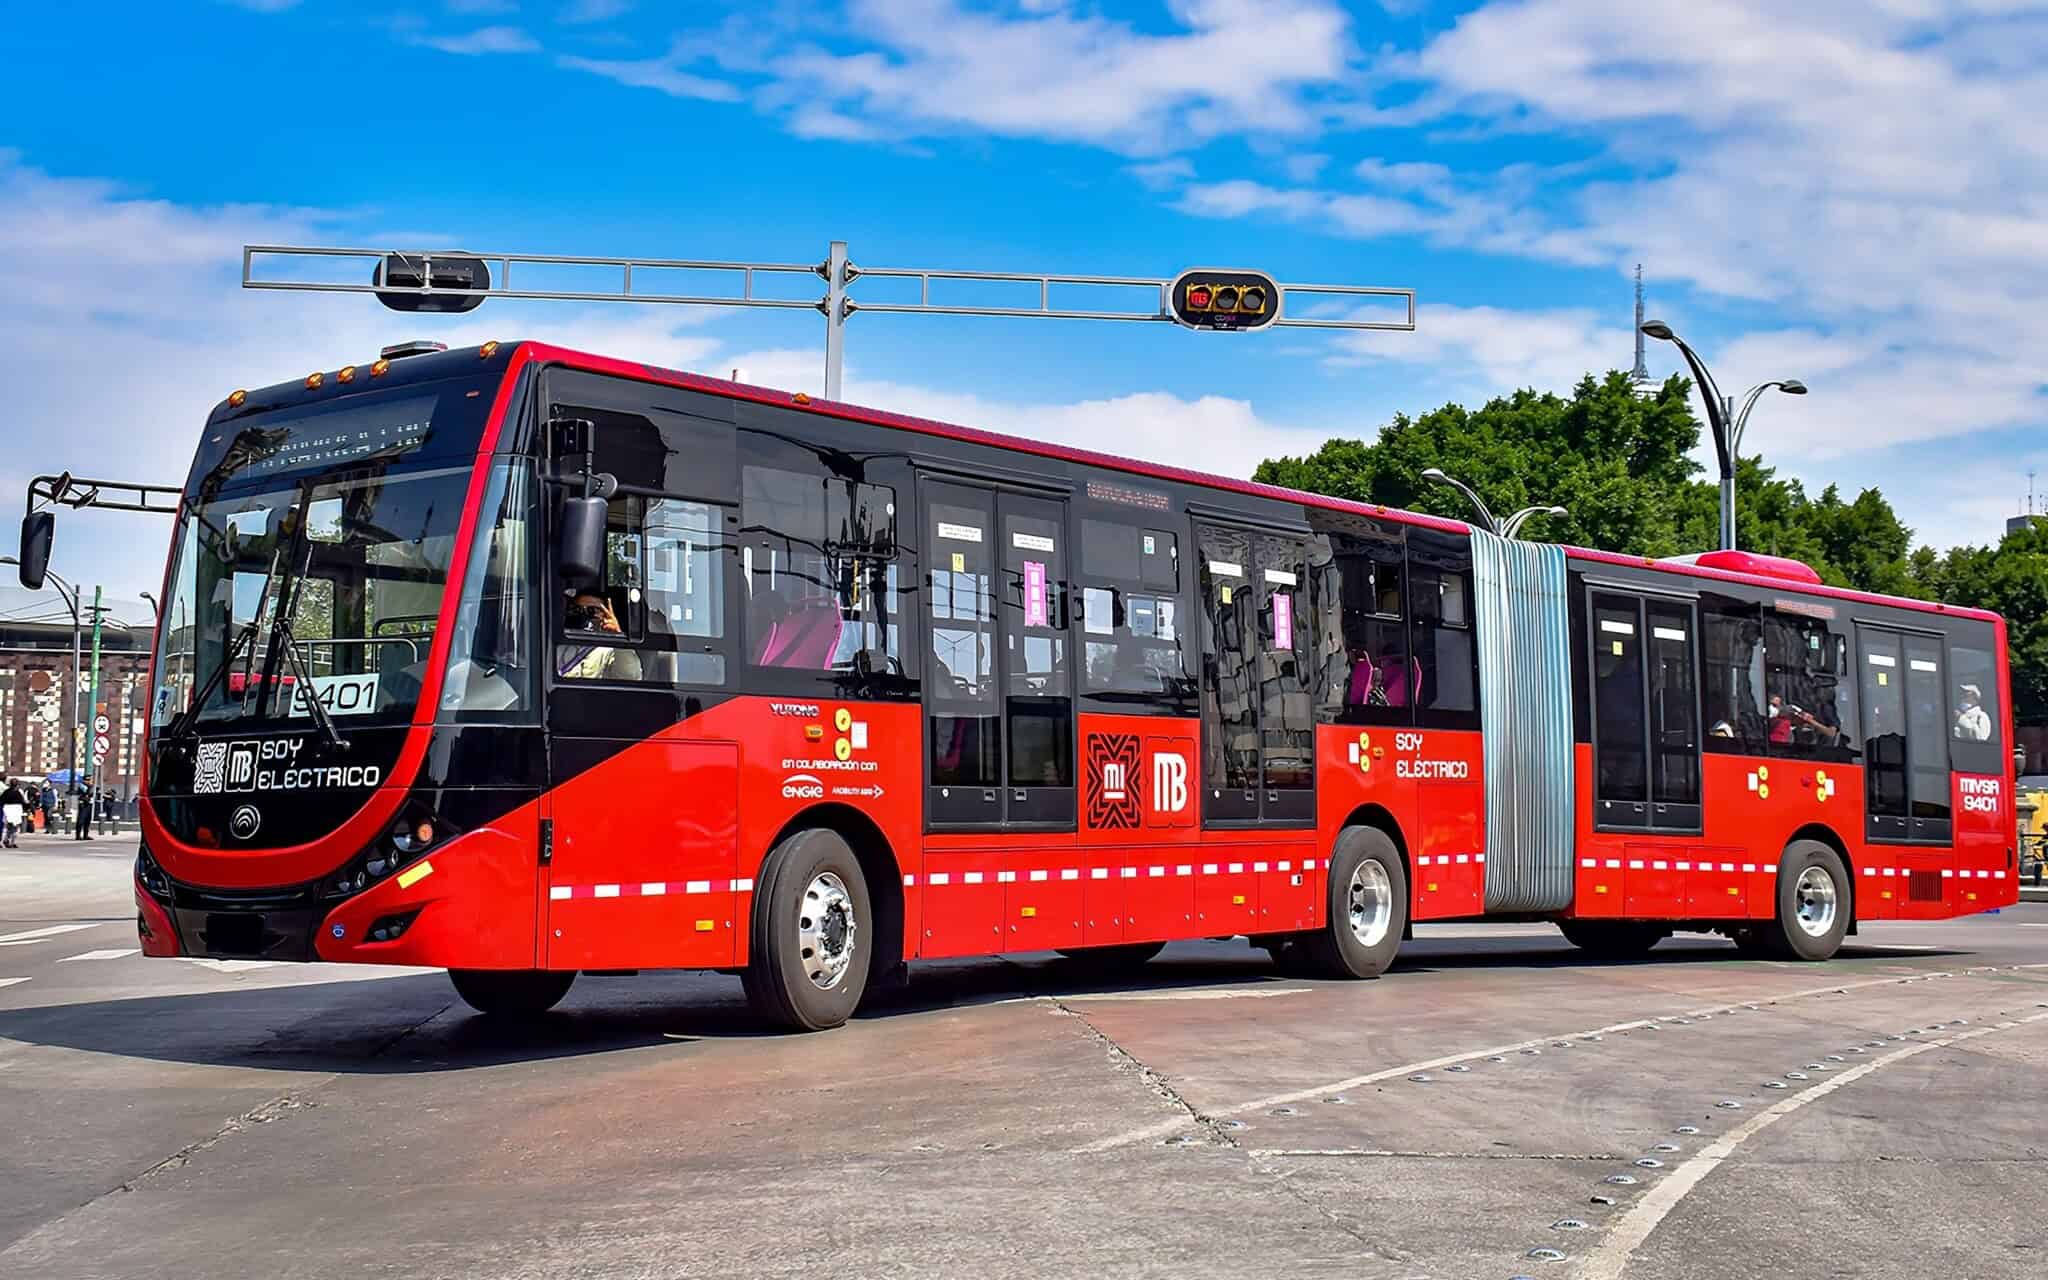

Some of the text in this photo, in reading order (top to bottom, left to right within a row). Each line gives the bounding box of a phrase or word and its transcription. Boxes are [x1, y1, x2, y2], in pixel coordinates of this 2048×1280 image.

[294, 681, 375, 712] 9401
[770, 703, 819, 717] YUTONG
[262, 738, 304, 760] SOY
[1395, 733, 1423, 751] SOY
[257, 761, 380, 790] ELÉCTRICO
[1396, 754, 1468, 778] ELÉCTRICO
[1963, 795, 1997, 812] 9401
